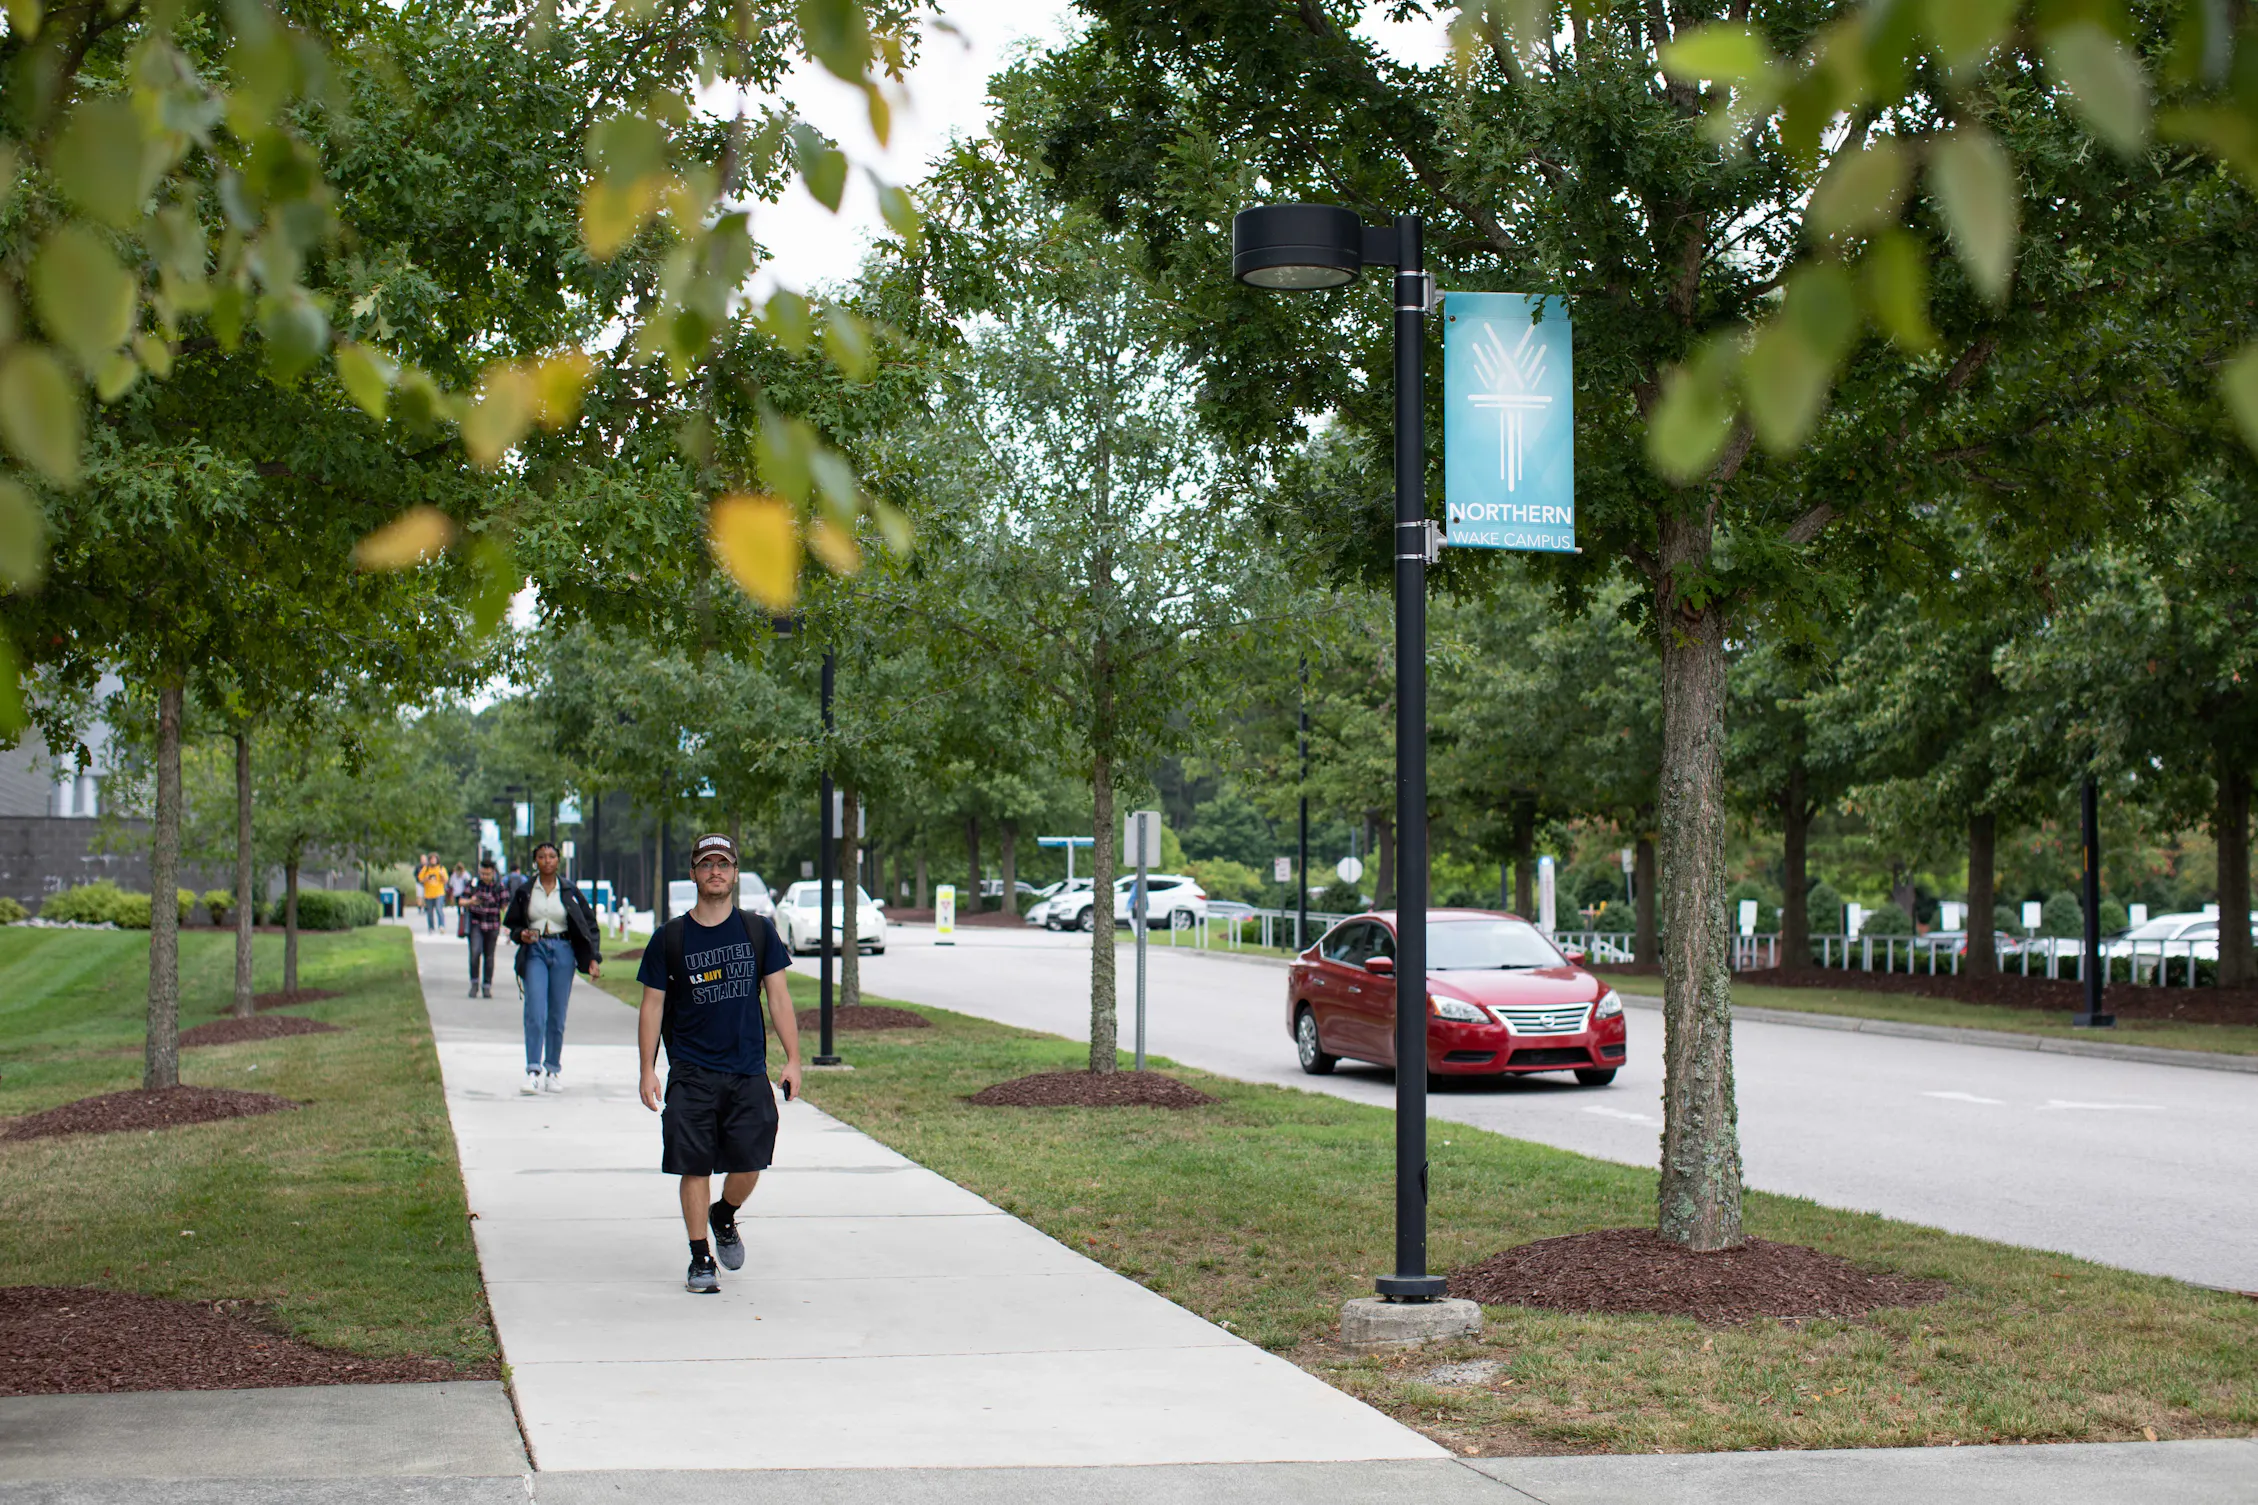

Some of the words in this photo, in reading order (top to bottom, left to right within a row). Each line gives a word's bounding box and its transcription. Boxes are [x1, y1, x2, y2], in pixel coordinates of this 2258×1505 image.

[1449, 502, 1572, 524] NORTHERN
[1452, 531, 1499, 546] WAKE
[1504, 533, 1571, 549] CAMPUS
[685, 942, 754, 970] UNITED
[726, 961, 755, 979] WE
